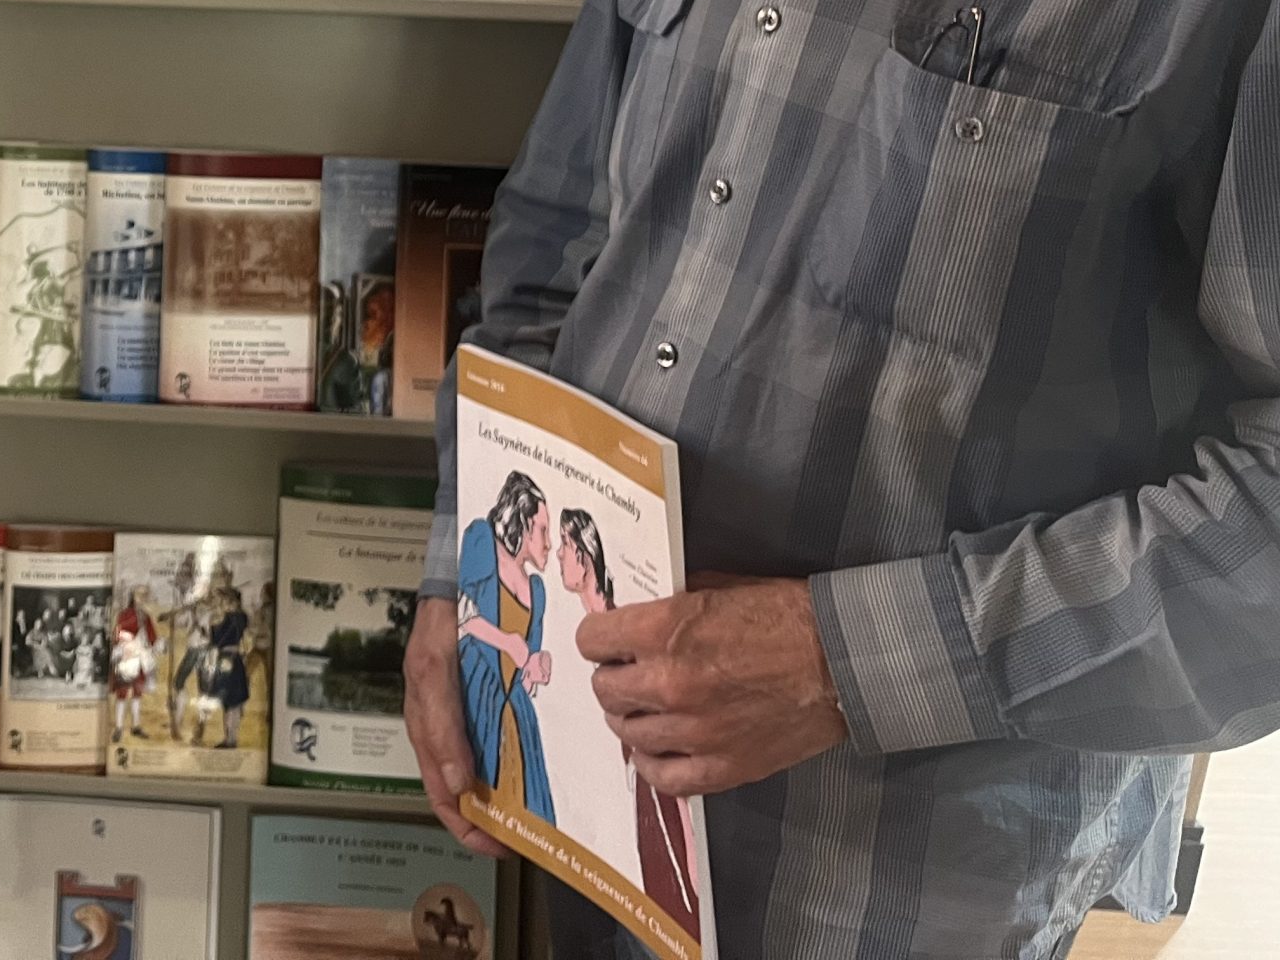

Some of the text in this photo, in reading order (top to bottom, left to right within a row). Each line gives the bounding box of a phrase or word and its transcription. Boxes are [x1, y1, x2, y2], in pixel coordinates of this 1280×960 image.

[478, 421, 493, 439] Les
[533, 444, 543, 460] de
[544, 448, 553, 467] la
[554, 455, 596, 490] seigneurie
[596, 478, 605, 496] de
[605, 484, 641, 523] Chambly
[506, 816, 555, 856] d'histoire
[556, 846, 569, 865] de
[570, 855, 582, 875] la
[583, 867, 633, 913] seigneurie
[634, 905, 649, 924] de
[648, 915, 689, 960] Chambly
